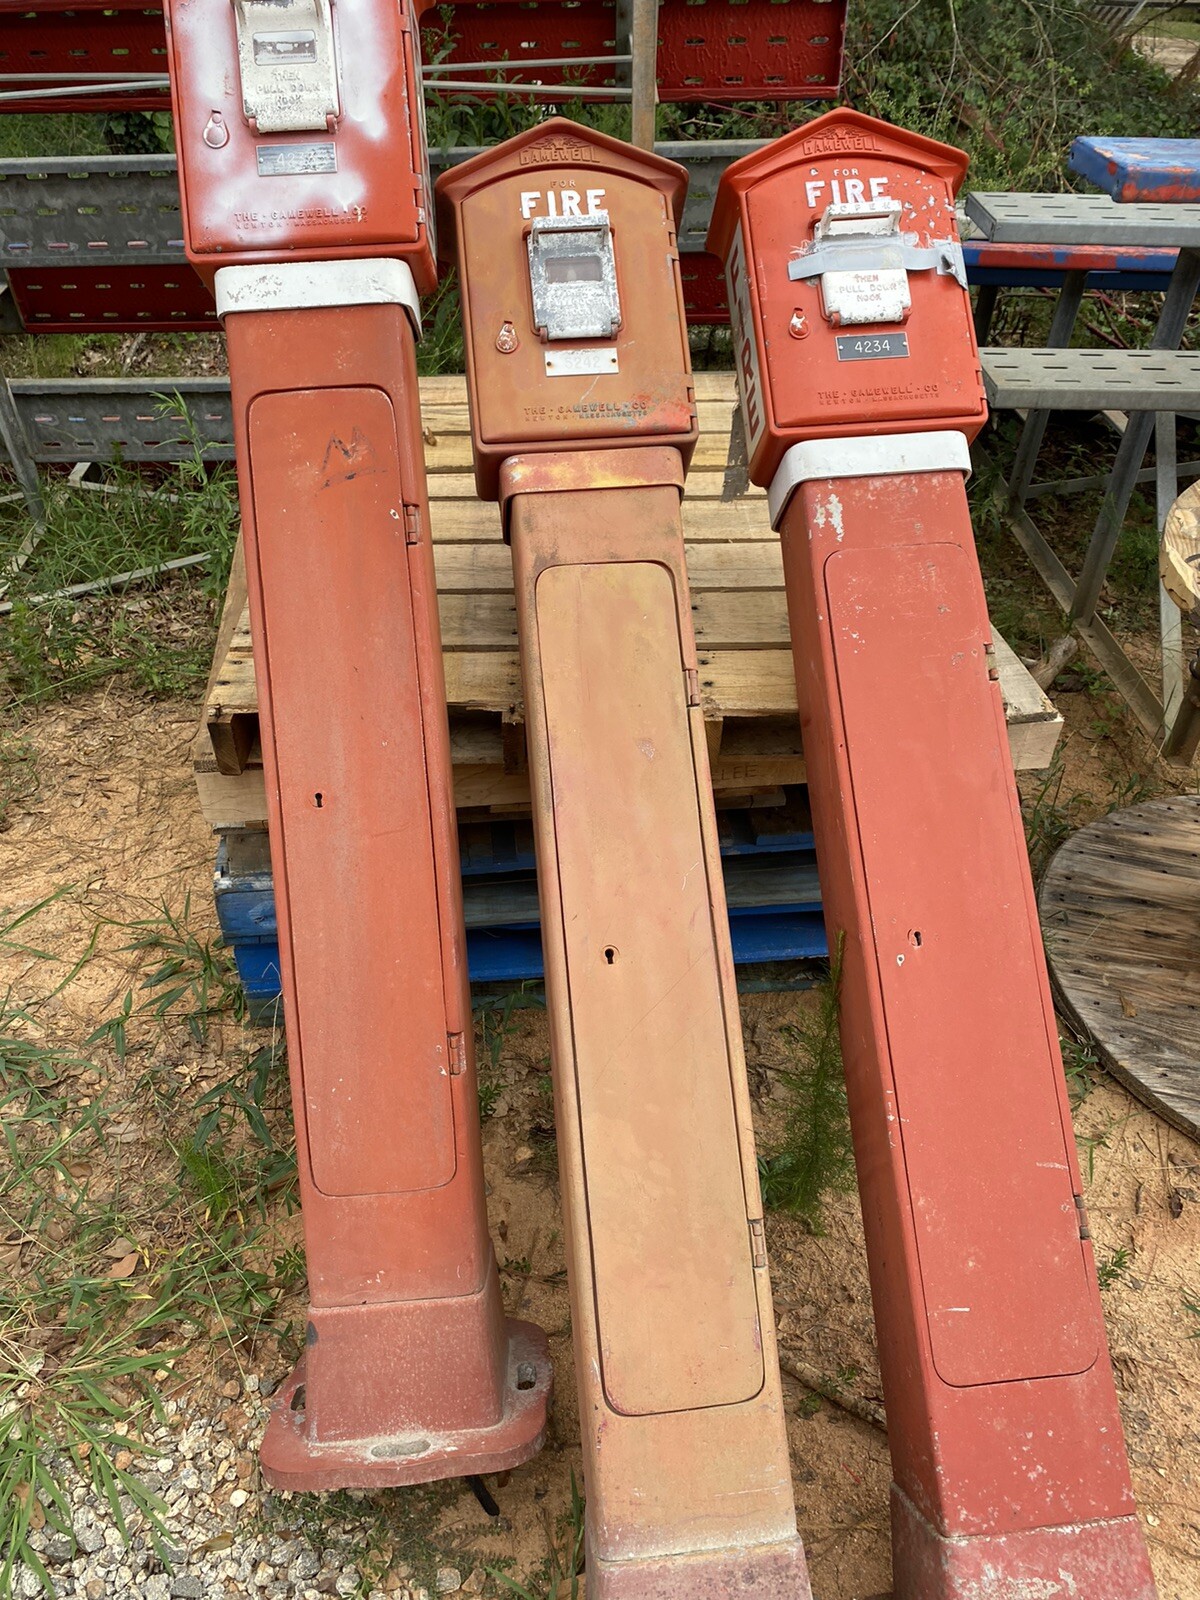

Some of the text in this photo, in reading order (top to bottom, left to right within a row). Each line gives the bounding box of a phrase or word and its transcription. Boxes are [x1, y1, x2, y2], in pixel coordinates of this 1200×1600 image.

[803, 135, 883, 155] GAMEWELL
[520, 147, 601, 166] GAMEWELL
[833, 168, 859, 177] FOR
[550, 180, 576, 188] FOR
[805, 177, 891, 208] FIRE
[521, 189, 608, 219] FIRE
[234, 211, 258, 222] THE
[271, 207, 338, 220] GAMEWELL
[853, 274, 879, 283] THEN
[839, 284, 865, 294] PULL
[730, 243, 760, 441] FIRE
[854, 340, 890, 353] 4234
[565, 355, 601, 368] 5242
[817, 384, 939, 399] THE GAMEWELL CO
[524, 402, 647, 415] THE GAMEWELL CO
